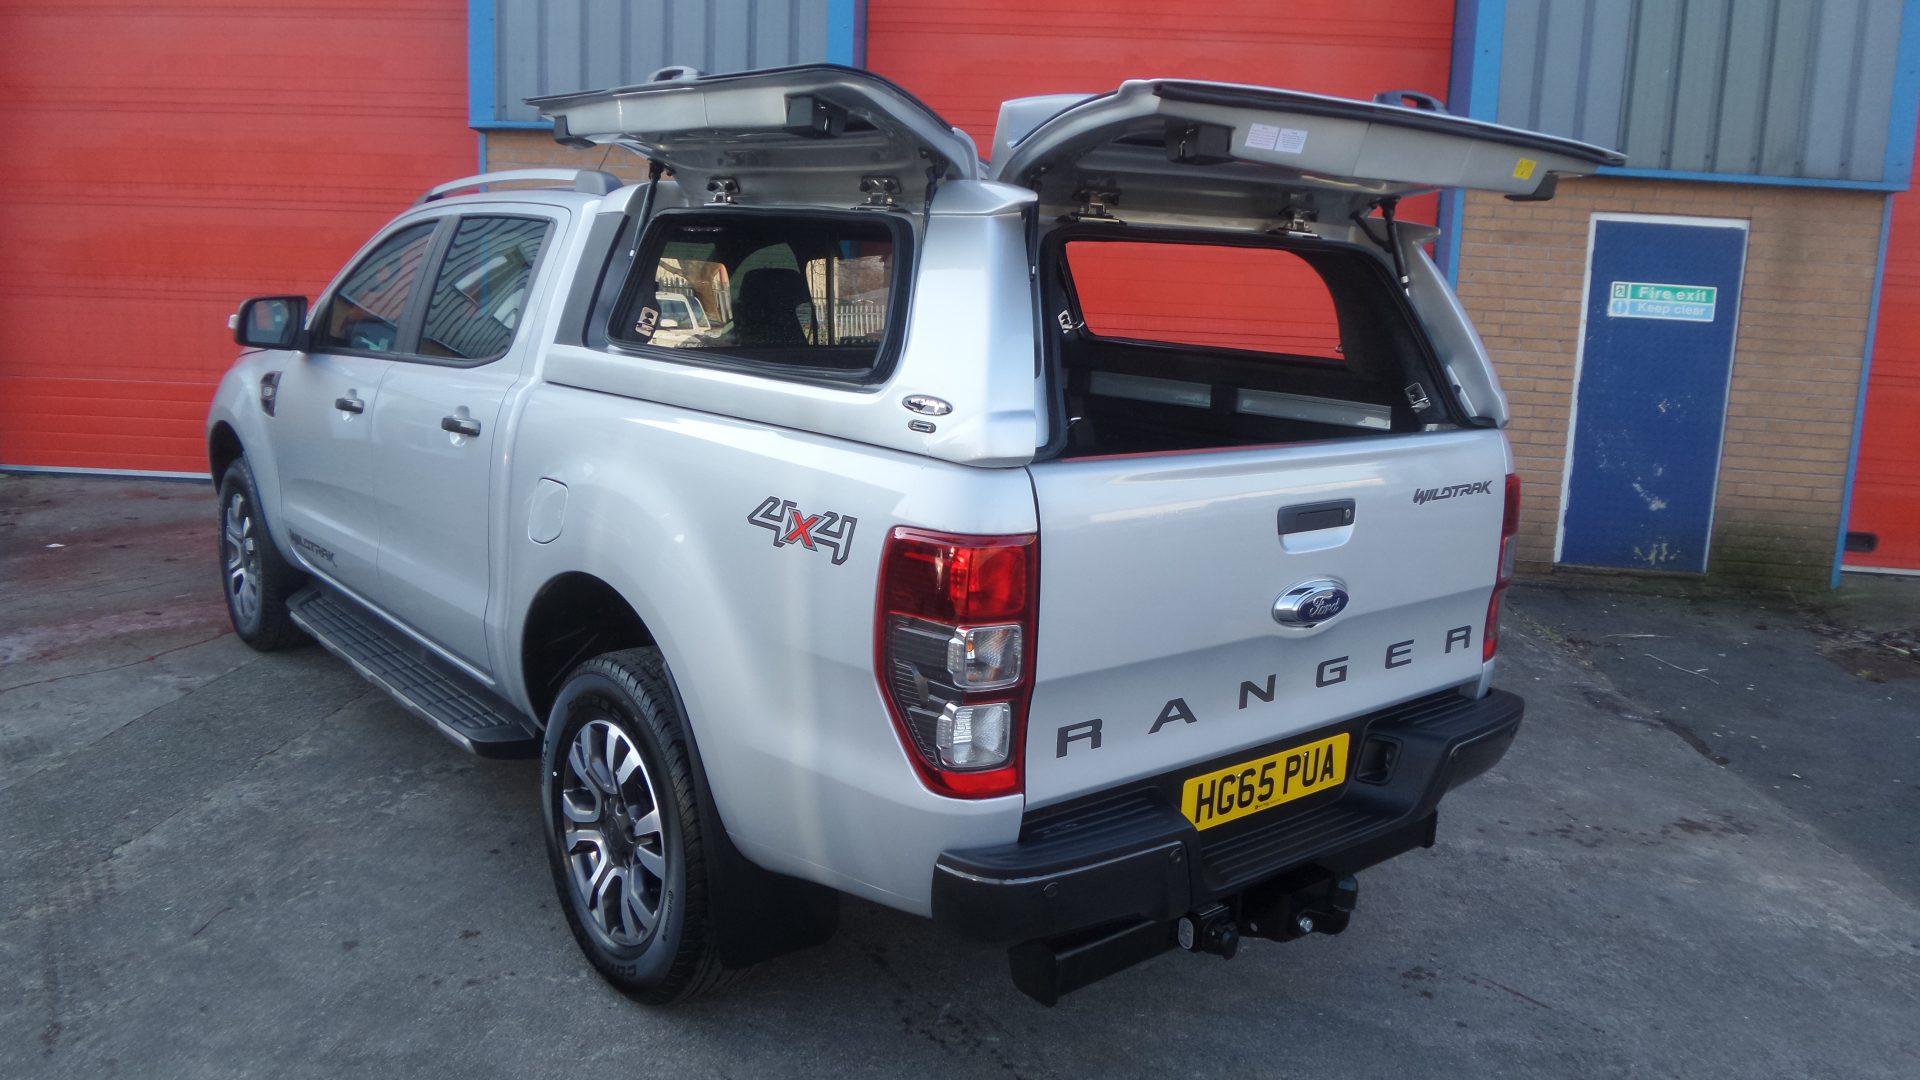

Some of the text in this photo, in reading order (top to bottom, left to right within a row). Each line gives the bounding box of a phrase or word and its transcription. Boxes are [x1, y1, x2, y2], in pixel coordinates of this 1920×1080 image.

[1639, 286, 1707, 302] Fire exit
[1638, 303, 1705, 316] Keep clear
[1412, 480, 1493, 505] WILDTRAK
[1309, 593, 1341, 617] Ford
[1056, 625, 1472, 758] RANGER
[1194, 744, 1336, 824] HG65 PUA
